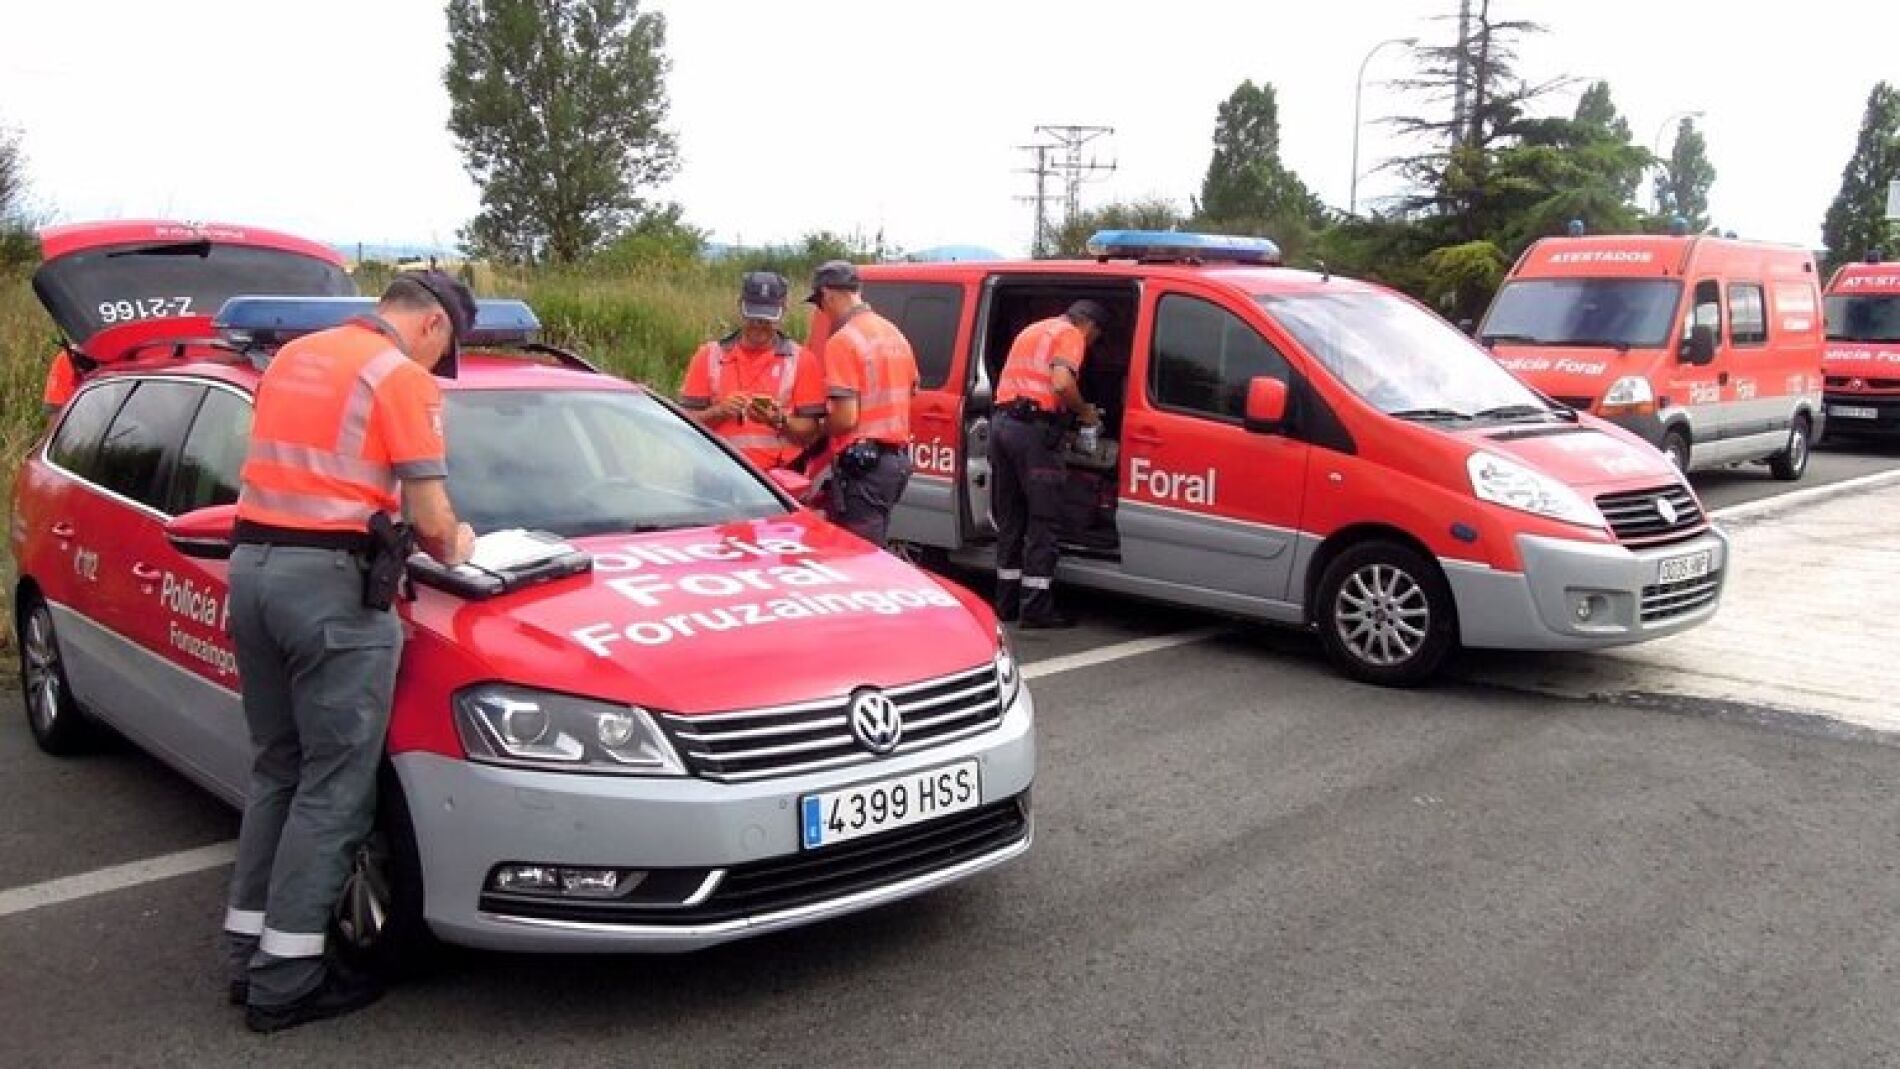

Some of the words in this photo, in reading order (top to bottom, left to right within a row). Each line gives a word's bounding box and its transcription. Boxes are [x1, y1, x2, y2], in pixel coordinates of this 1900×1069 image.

[98, 297, 196, 322] Z-2166
[909, 436, 956, 472] icía
[1129, 457, 1216, 505] Foral
[593, 536, 812, 571] olicía
[611, 560, 847, 607] Foral
[574, 586, 959, 656] Foruzaingoa
[828, 784, 908, 832] 4399
[919, 768, 971, 812] HSS
